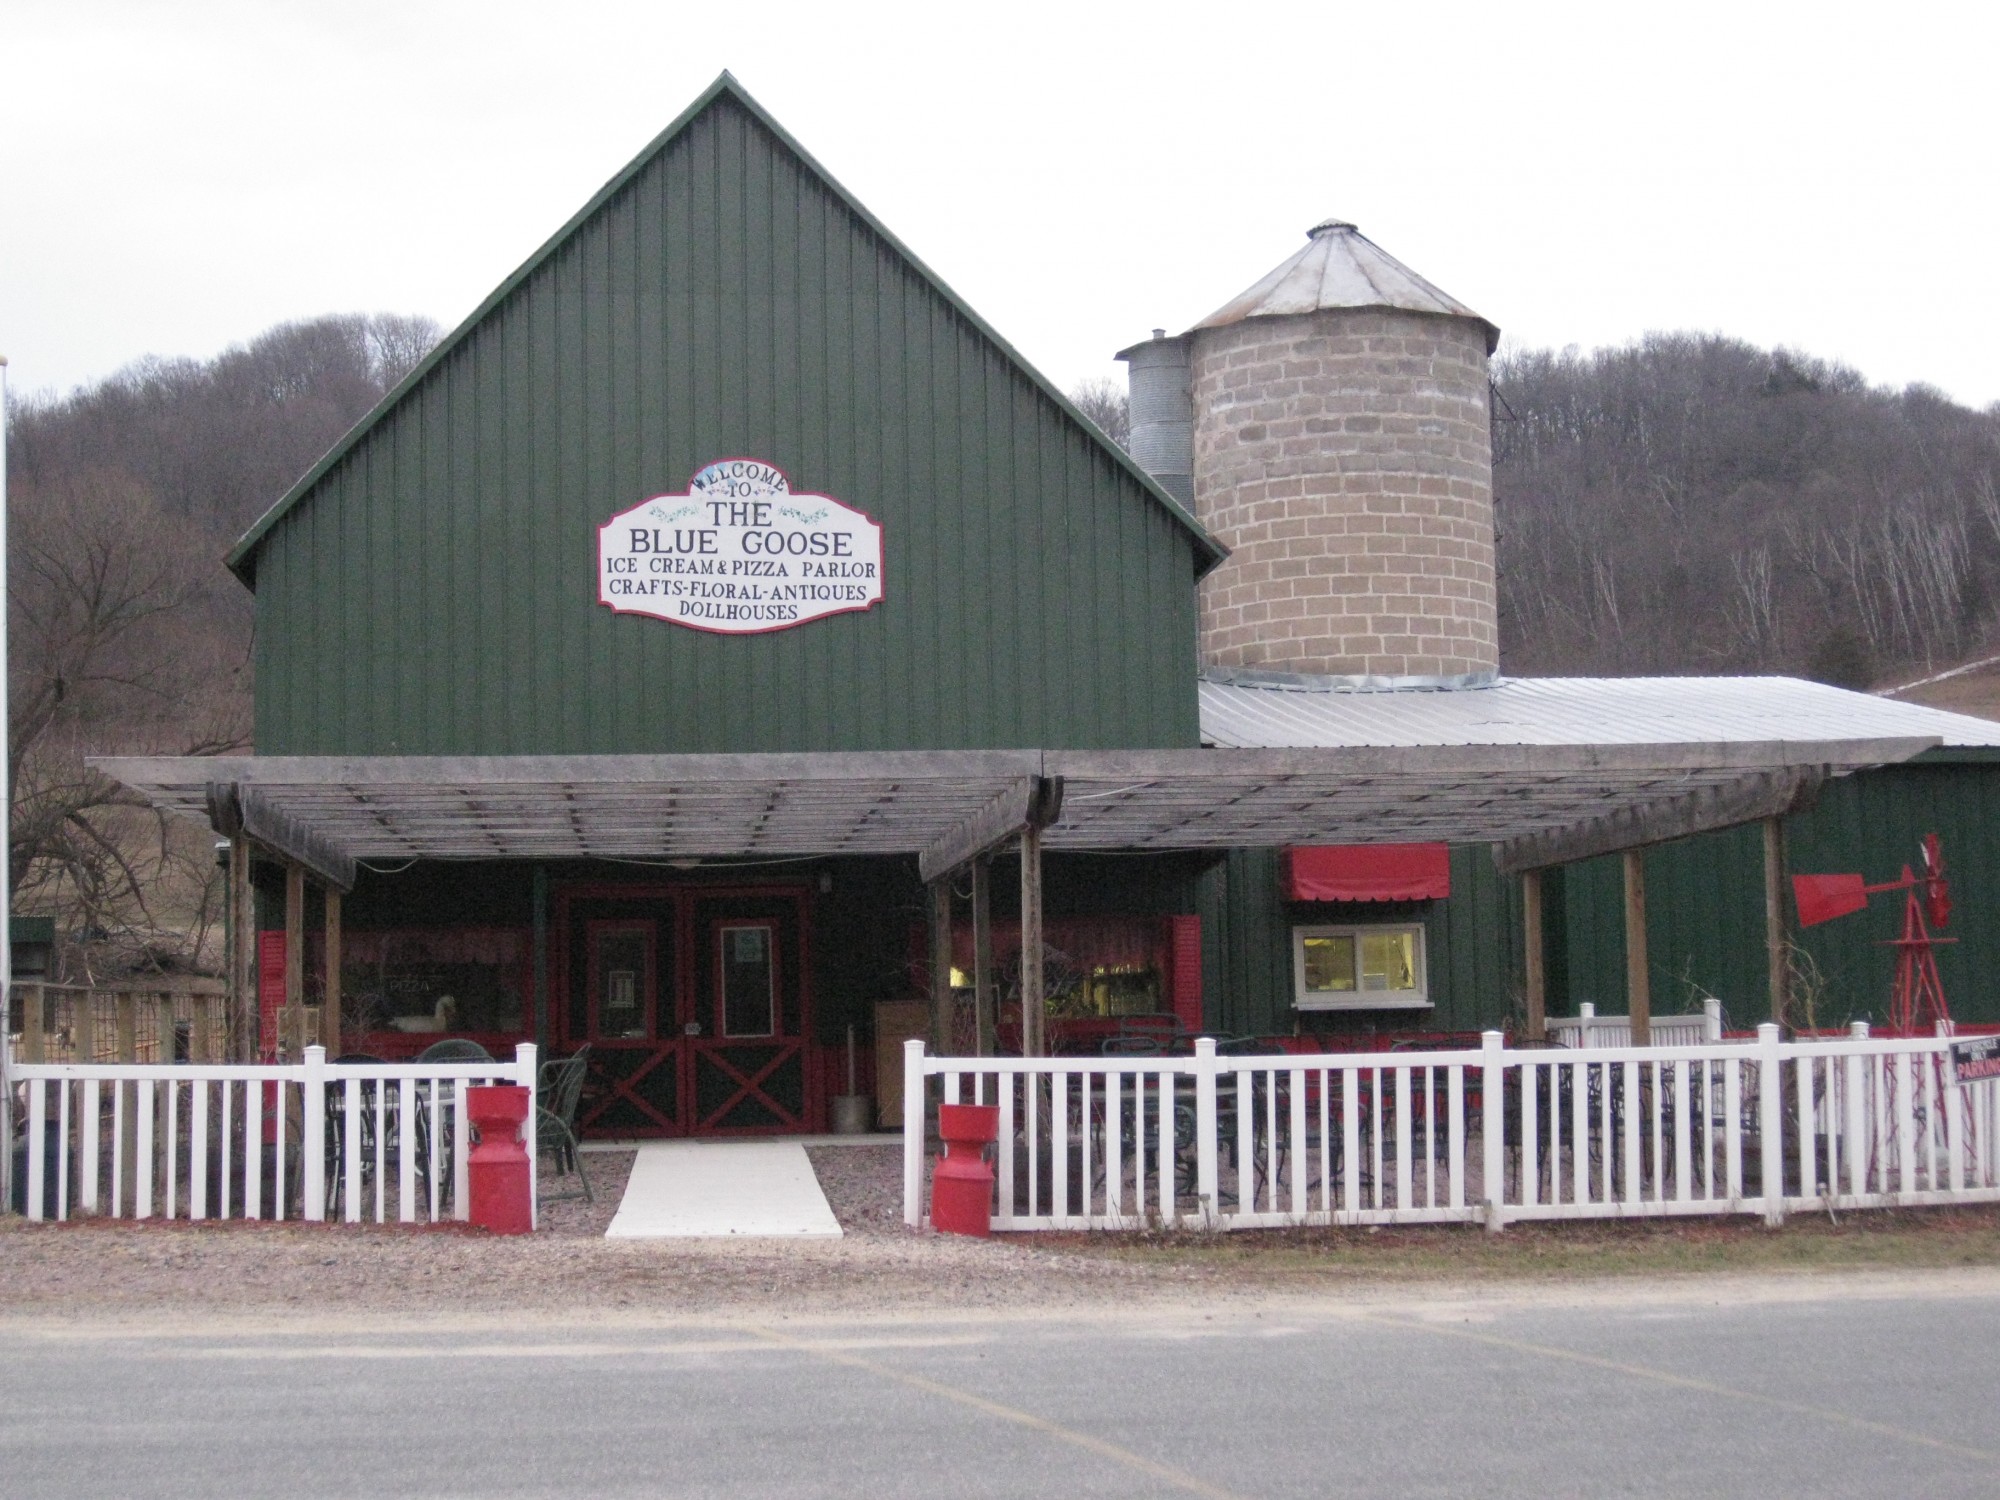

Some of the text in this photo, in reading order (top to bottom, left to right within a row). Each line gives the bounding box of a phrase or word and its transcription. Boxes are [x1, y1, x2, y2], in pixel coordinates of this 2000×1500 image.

[691, 462, 788, 491] WELCOME
[727, 481, 751, 497] TO
[706, 501, 772, 527] THE
[629, 529, 853, 557] BLUE GOOSE
[606, 557, 638, 574] ICE
[732, 560, 789, 577] PIZZA
[802, 562, 876, 578] PARLOR
[679, 601, 798, 620] DOLLHOUSES
